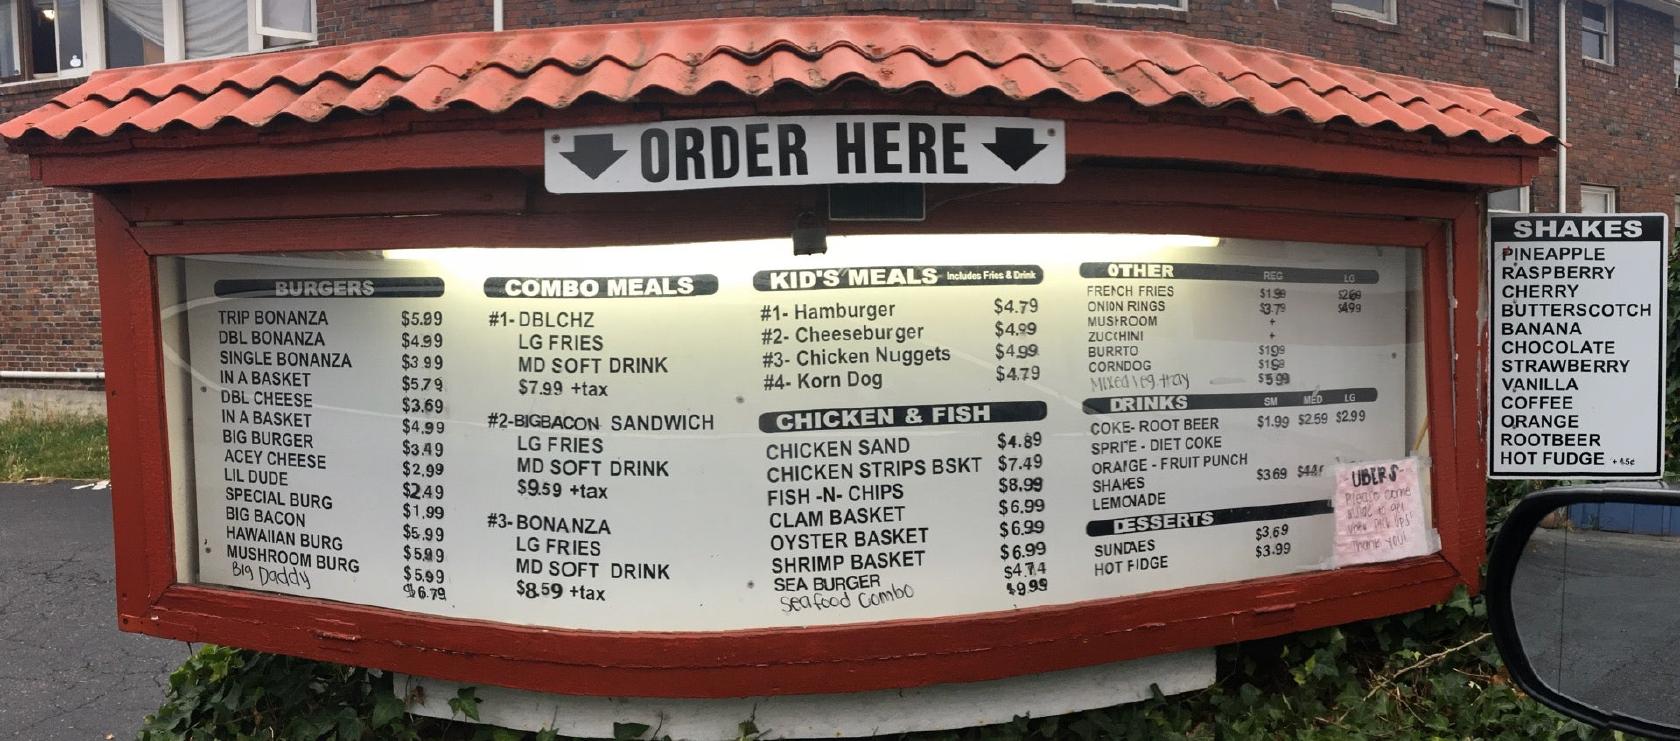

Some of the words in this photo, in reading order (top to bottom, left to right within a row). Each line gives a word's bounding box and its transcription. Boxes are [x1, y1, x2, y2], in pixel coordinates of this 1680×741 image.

[640, 122, 808, 183] ORDER
[836, 121, 969, 174] HERE
[1513, 220, 1642, 238] SHAKES
[1502, 248, 1605, 261] PINEAPPLE
[770, 269, 840, 290] KID'S
[848, 268, 938, 286] MEALS
[946, 271, 981, 280] Includes
[983, 270, 1004, 280] Fries
[1006, 270, 1012, 280] &
[1014, 270, 1036, 280] Drink
[1108, 264, 1174, 278] OTHER
[1264, 271, 1283, 280] REG
[1502, 266, 1615, 279] RASPBERRY
[275, 280, 375, 296] BURGERS
[505, 279, 600, 297] COMBO
[607, 276, 694, 296] MEALS
[1139, 286, 1174, 297] FRIES
[1502, 284, 1579, 298] CHERRY
[760, 304, 788, 321] #1-
[794, 302, 896, 320] Hamburger
[994, 298, 1038, 314] $4.79
[1088, 301, 1123, 312] ONION
[1128, 301, 1165, 312] RINGS
[1502, 303, 1651, 317] BUTTERSCOTCH
[219, 311, 249, 325] TRIP
[254, 311, 328, 326] BONANZA
[519, 312, 594, 328] DBLCHZ
[761, 328, 789, 345] #2-
[796, 324, 924, 344] Cheeseburger
[1502, 322, 1582, 335] BANANA
[219, 330, 247, 345] DBL
[251, 331, 325, 346] BONANZA
[402, 332, 443, 348] $4.99
[519, 334, 542, 350] LG
[549, 334, 604, 351] FRIES
[1502, 340, 1615, 354] CHOCOLATE
[220, 350, 272, 366] SINGLE
[277, 352, 352, 368] BONANZA
[519, 357, 545, 373] MD
[551, 358, 602, 373] SOFT
[609, 356, 668, 373] DRINK
[762, 351, 790, 368] #3-
[796, 348, 869, 367] Chicken
[876, 346, 950, 366] Nuggets
[996, 366, 1040, 382] $4.79
[1089, 361, 1152, 373] CORNDOG
[1502, 360, 1630, 373] STRAWBERRY
[220, 370, 234, 384] IN
[238, 371, 248, 384] A
[252, 371, 311, 387] BASKET
[402, 375, 443, 392] $5.79
[764, 374, 791, 390] #4-
[798, 372, 841, 390] Korn
[848, 370, 883, 389] Dog
[1502, 378, 1578, 391] VANILLA
[518, 380, 563, 395] $7.99
[571, 382, 608, 397] +tax
[221, 390, 249, 404] DBL
[254, 391, 312, 407] CHEESE
[1110, 395, 1188, 412] DRINKS
[1264, 397, 1278, 406] SM
[1304, 395, 1323, 404] MED
[1345, 394, 1356, 402] LG
[1502, 396, 1573, 409] COFFEE
[222, 409, 235, 423] IN
[239, 410, 249, 424] A
[253, 411, 312, 428] BASKET
[611, 414, 714, 432] SANDWICH
[776, 408, 894, 430] CHICKEN
[905, 407, 923, 424] &
[932, 404, 990, 423] FISH
[1257, 415, 1289, 428] $1.99
[1298, 413, 1328, 425] $2.59
[1502, 415, 1579, 429] ORANGE
[402, 417, 445, 435] $4.99
[1090, 421, 1135, 435] COKE-
[1139, 419, 1180, 432] ROOT
[1184, 417, 1220, 430] BEER
[223, 429, 247, 444] BIG
[251, 430, 313, 448] BURGER
[517, 436, 542, 451] LG
[548, 437, 604, 454] FRIES
[997, 432, 1042, 450] $4.89
[1150, 438, 1181, 451] DIET
[1185, 436, 1222, 449] COKE
[1501, 433, 1601, 446] ROOTBEER
[403, 439, 444, 457] $3.49
[766, 440, 852, 460] CHICKEN
[858, 437, 910, 455] SAND
[224, 449, 262, 464] ACEY
[267, 451, 326, 469] CHEESE
[517, 457, 544, 473] MD
[550, 459, 602, 476] SOFT
[610, 460, 669, 477] DRINK
[998, 454, 1043, 472] $7.49
[1161, 456, 1200, 470] FRUIT
[1203, 453, 1248, 467] PUNCH
[1501, 452, 1537, 465] HOT
[1543, 452, 1604, 465] FUDGE
[224, 468, 244, 482] LIL
[249, 470, 288, 486] DUDE
[403, 460, 444, 477] $2.99
[766, 463, 853, 483] CHICKEN
[859, 460, 926, 479] STRIPS
[932, 457, 982, 475] BSKT
[403, 482, 444, 499] $2.49
[517, 479, 562, 497] $9.59
[570, 484, 608, 499] +tax
[998, 476, 1044, 494] $8.99
[1093, 477, 1145, 493] SHAKES
[226, 487, 285, 506] SPECIAL
[290, 492, 333, 509] BURG
[768, 488, 810, 506] FISH
[848, 484, 904, 501] CHIPS
[1093, 493, 1166, 510] LEMONADE
[403, 502, 444, 519] $1.99
[998, 498, 1045, 516] $6.99
[226, 507, 249, 521] BIG
[254, 508, 306, 527] BACON
[770, 510, 824, 528] CLAM
[829, 506, 906, 526] BASKET
[1114, 512, 1214, 534] DESSERTS
[403, 523, 444, 541] $5.99
[1000, 520, 1045, 538] $6.99
[1256, 524, 1289, 541] $3.69
[227, 526, 295, 546] HAWAIIAN
[300, 533, 343, 550] BURG
[516, 536, 540, 552] LG
[546, 538, 601, 556] FRIES
[770, 532, 848, 551] OYSTER
[854, 527, 929, 547] BASKET
[1000, 542, 1046, 560] $6.99
[1094, 539, 1156, 557] SUNDAES
[1256, 542, 1291, 558] $3.99
[227, 544, 312, 568] MUSHROOM
[316, 555, 360, 573] BURG
[771, 556, 844, 574] SHRIMP
[851, 550, 926, 570] BASKET
[403, 565, 444, 584] $5.99
[516, 558, 542, 574] MD
[549, 561, 599, 578] SOFT
[611, 563, 670, 580] DRINK
[1094, 561, 1123, 576] HOT
[259, 566, 311, 589] Daddy
[774, 576, 808, 592] SEA
[813, 574, 880, 591] BURGER
[570, 585, 606, 601] +tax
